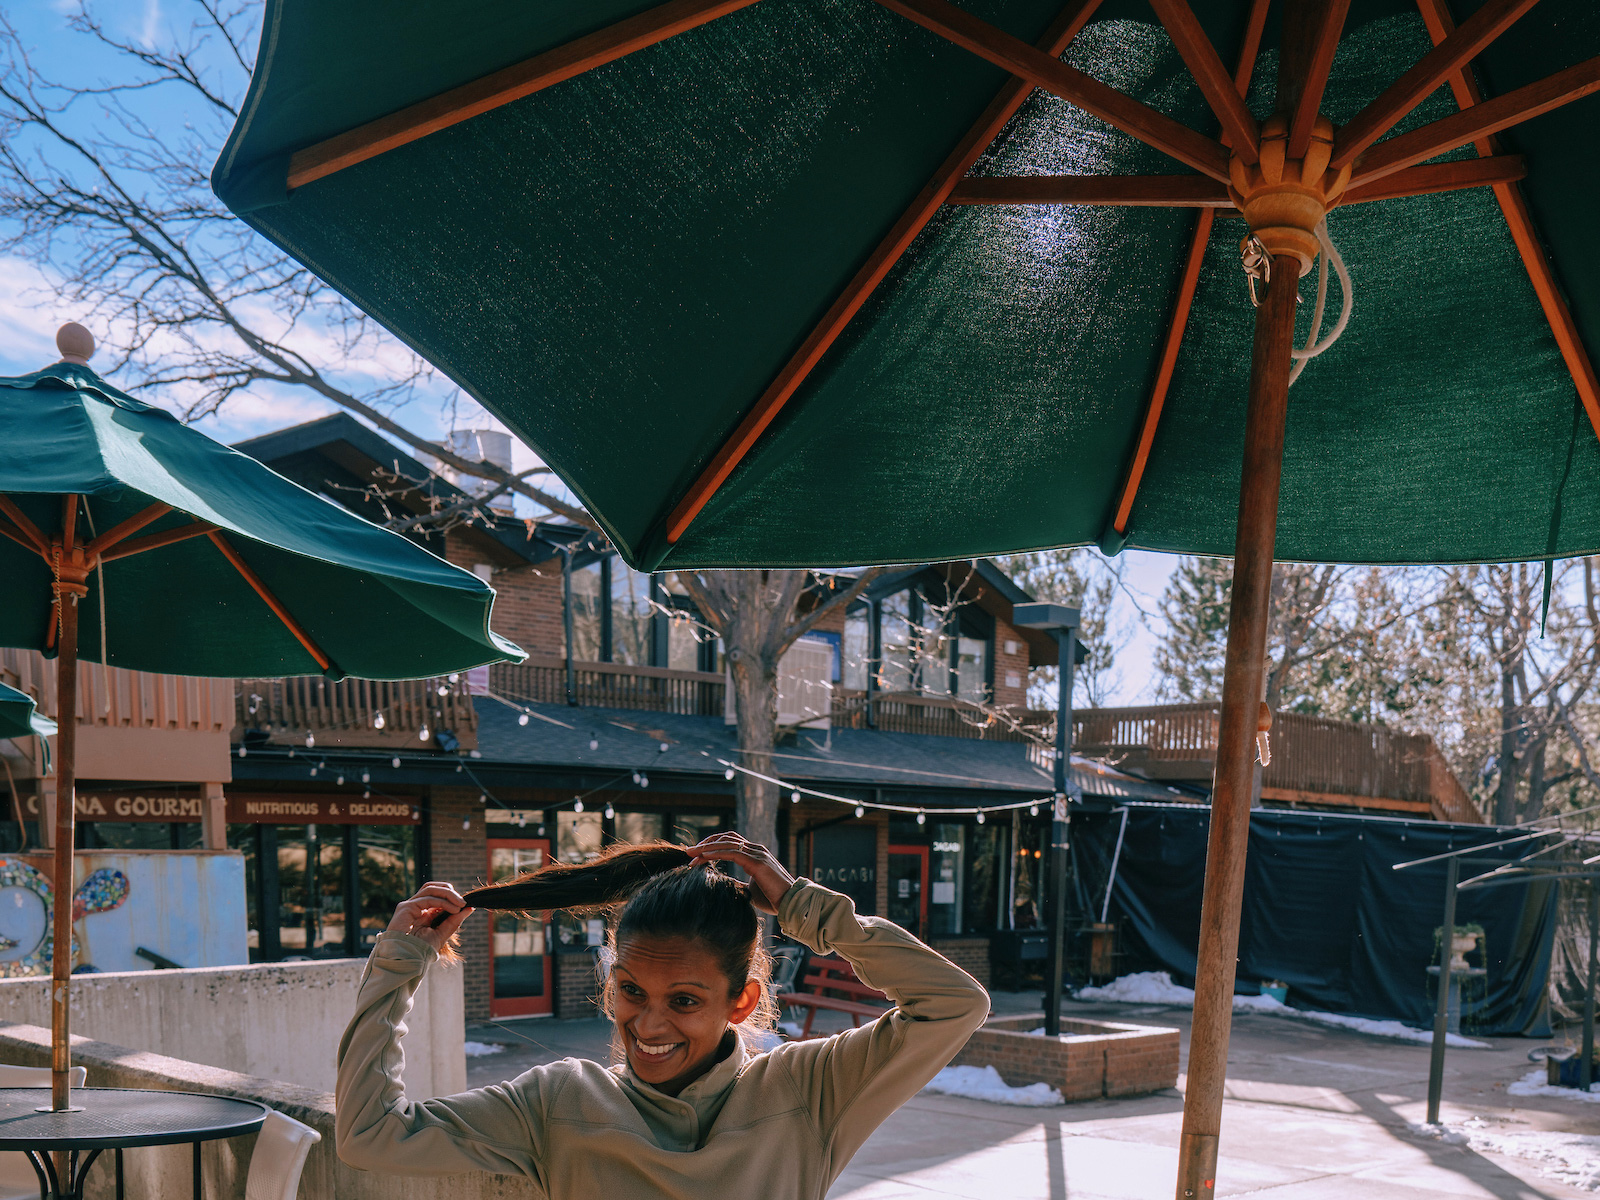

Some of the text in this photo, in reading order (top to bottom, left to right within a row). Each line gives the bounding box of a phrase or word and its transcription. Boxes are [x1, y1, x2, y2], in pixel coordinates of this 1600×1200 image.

[27, 796, 227, 817] CNA GOURM
[246, 802, 410, 816] NUTRITIOUS & DELICIOUS
